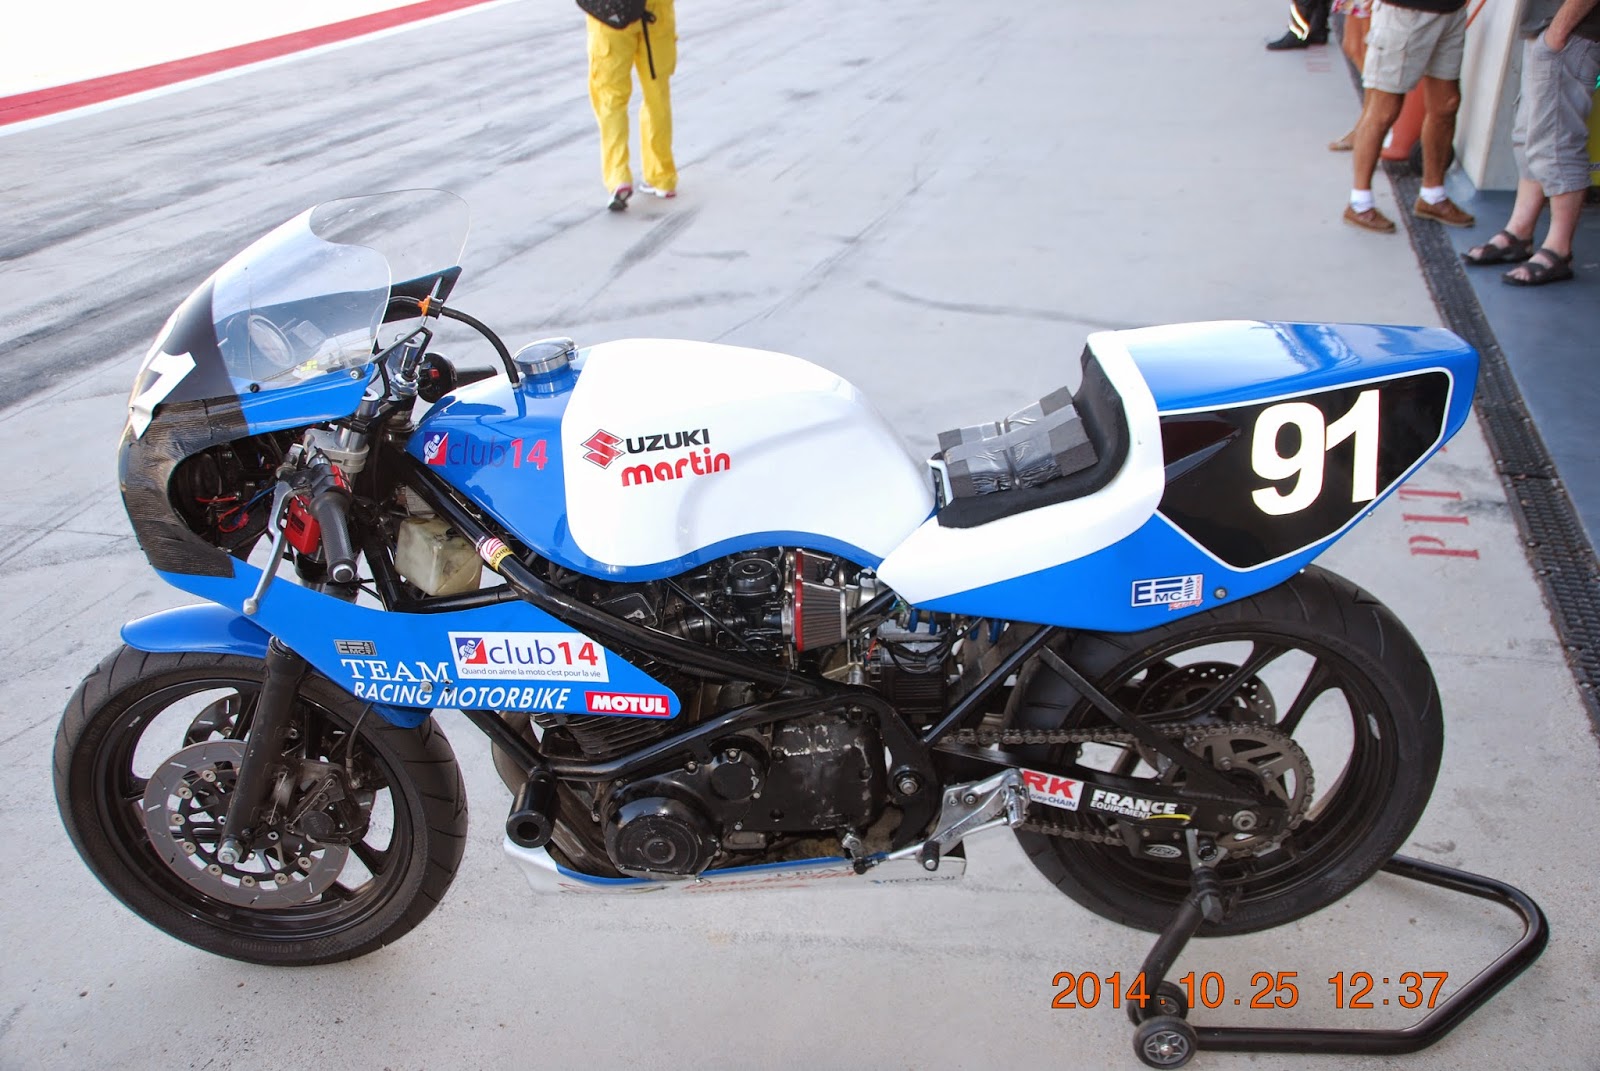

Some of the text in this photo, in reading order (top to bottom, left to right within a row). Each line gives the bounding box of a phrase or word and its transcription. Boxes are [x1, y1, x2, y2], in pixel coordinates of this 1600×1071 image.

[1252, 389, 1380, 516] 91
[621, 447, 731, 487] martin
[341, 659, 453, 683] TEAM
[462, 667, 486, 675] Quand
[499, 668, 517, 676] aime
[518, 668, 525, 676] la
[526, 669, 546, 677] moto
[547, 668, 562, 677] c'est
[564, 670, 581, 678] pour
[582, 670, 589, 678] la
[590, 670, 601, 678] vie
[354, 682, 572, 710] RACING MOTORBIKE
[592, 695, 667, 714] MOTUL
[1023, 770, 1077, 800] RK
[1048, 796, 1076, 808] CHAIN
[1090, 800, 1153, 819] EQUIPEMENT
[1092, 789, 1178, 815] FRANCE
